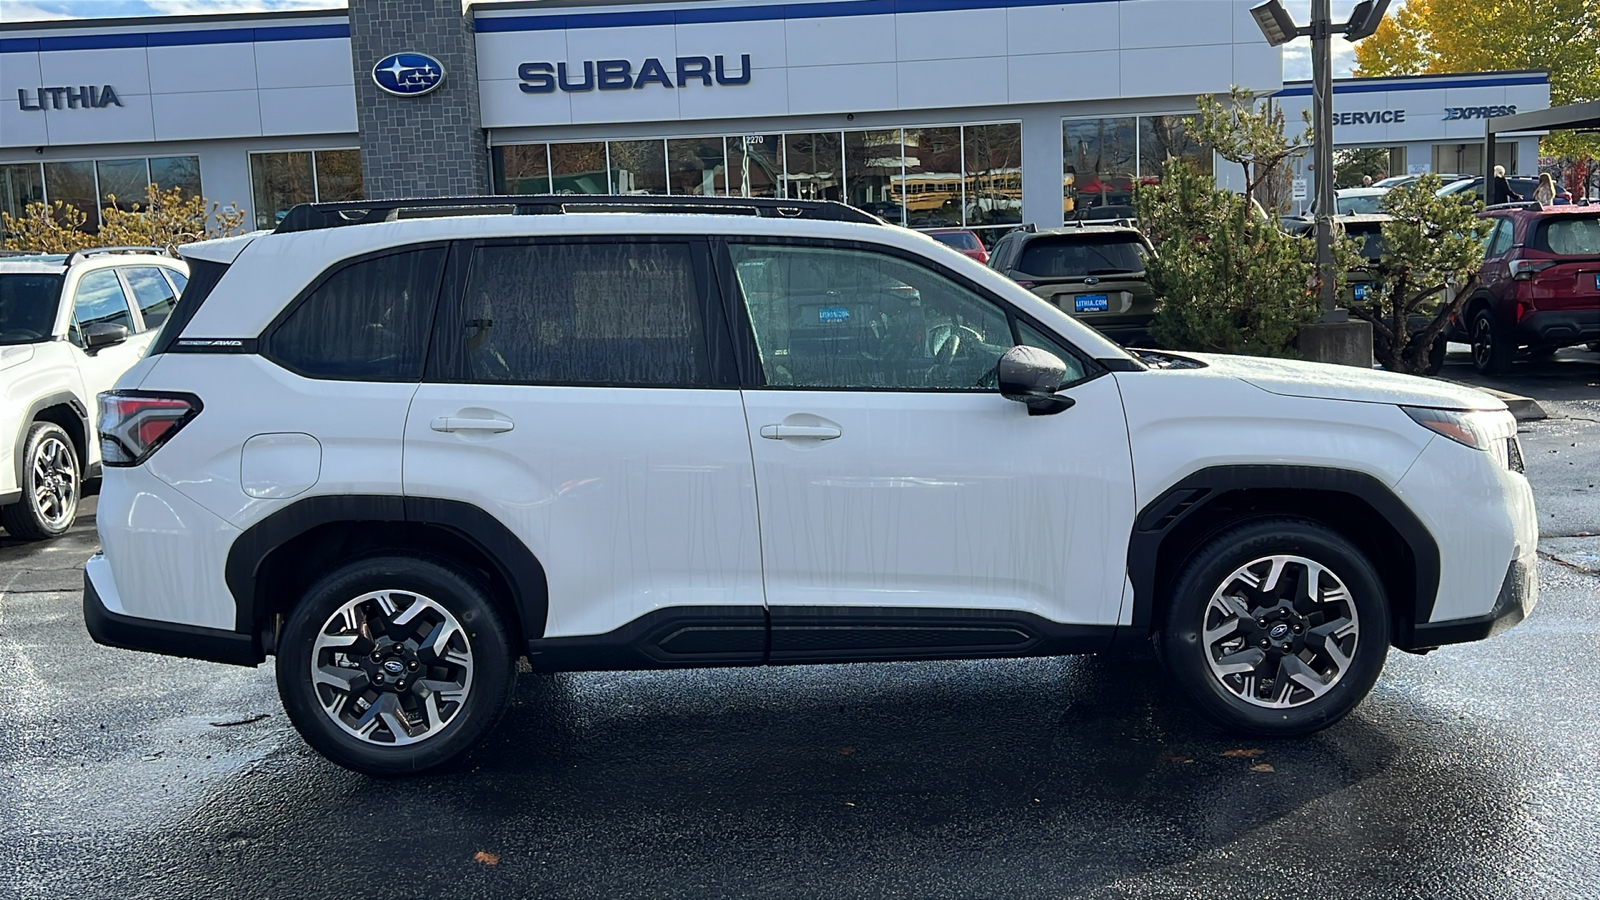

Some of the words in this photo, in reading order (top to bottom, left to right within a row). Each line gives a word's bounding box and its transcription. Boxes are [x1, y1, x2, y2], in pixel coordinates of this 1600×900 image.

[518, 54, 751, 93] SUBARU
[18, 85, 123, 111] LITHIA
[1333, 110, 1405, 126] SERVICE
[1442, 105, 1517, 121] EXPRESS
[746, 135, 764, 144] 2270
[1076, 299, 1107, 307] LITHIA.COM
